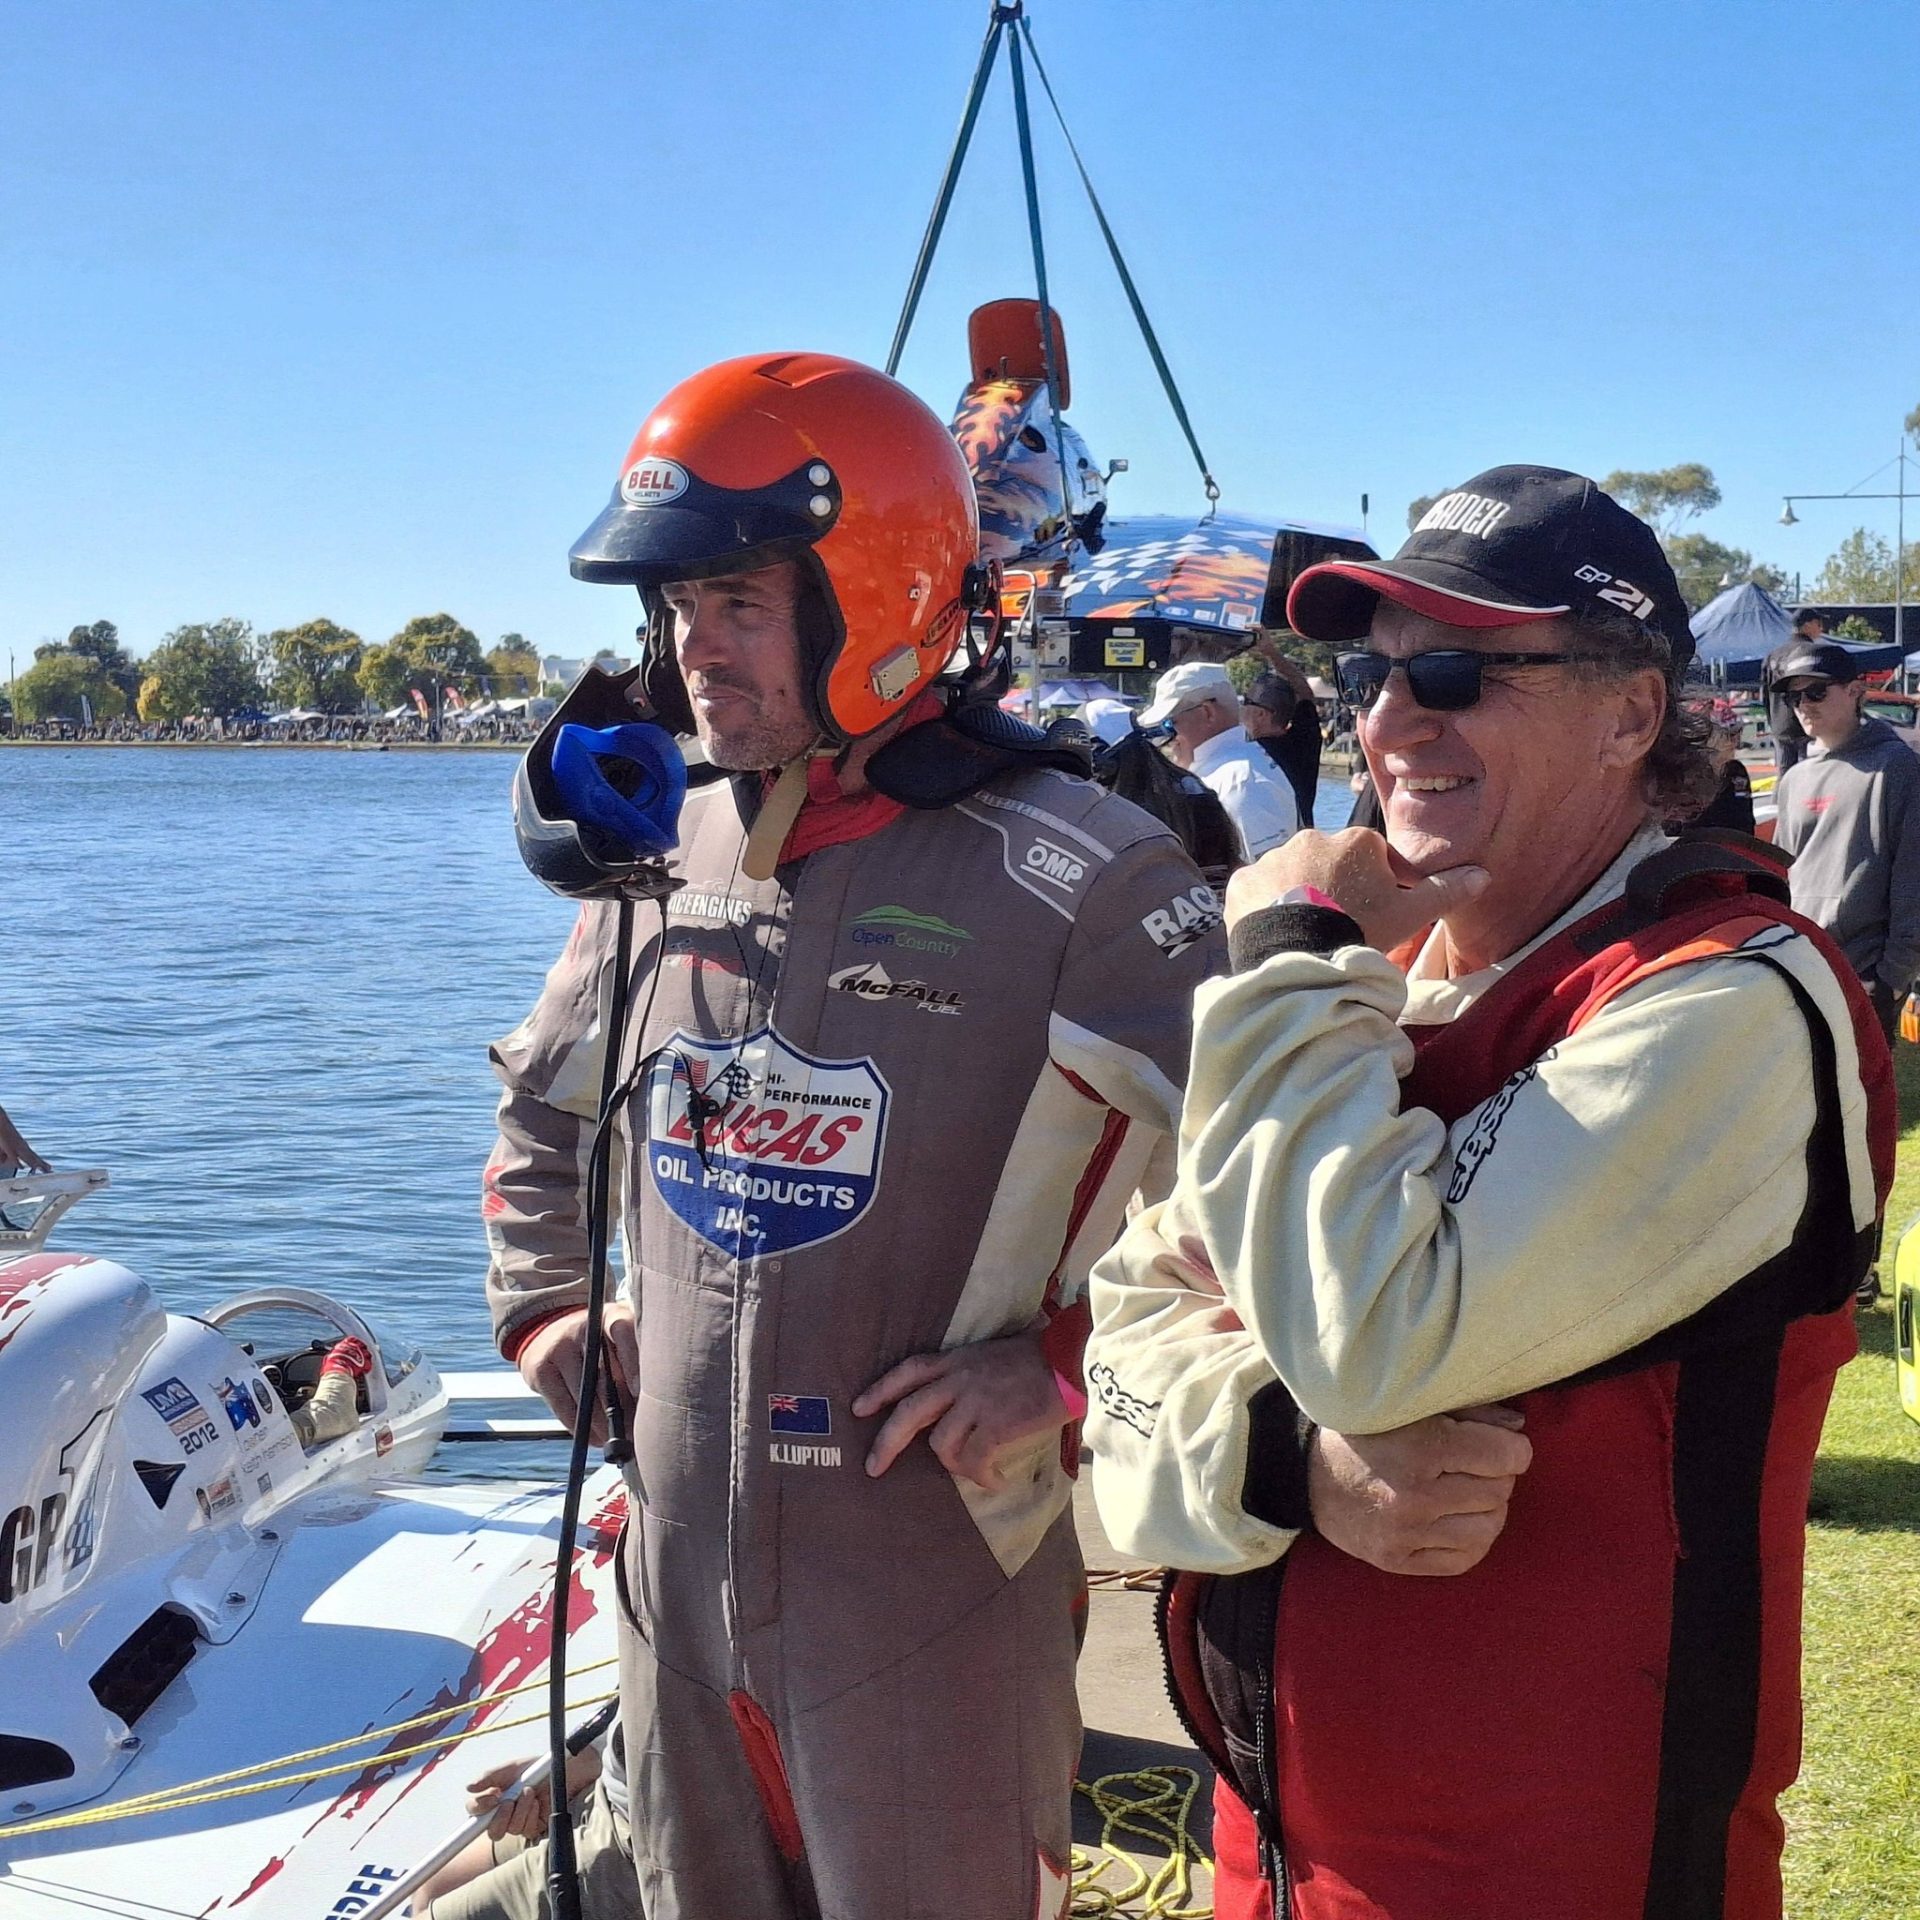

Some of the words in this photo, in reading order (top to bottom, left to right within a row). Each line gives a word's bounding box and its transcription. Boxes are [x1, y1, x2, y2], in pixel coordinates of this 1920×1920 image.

[628, 471, 675, 490] BELL
[1574, 564, 1612, 583] GP
[1596, 579, 1655, 620] 21
[1026, 845, 1084, 883] OMP
[917, 1001, 963, 1016] FUEL
[766, 1072, 786, 1084] HI-
[764, 1089, 872, 1110] PERFORMANCE
[666, 1094, 864, 1166] LUCAS
[656, 1154, 694, 1185] OIL
[702, 1166, 856, 1211] PRODUCTS
[715, 1205, 767, 1240] INC.
[179, 1421, 220, 1455] 2012
